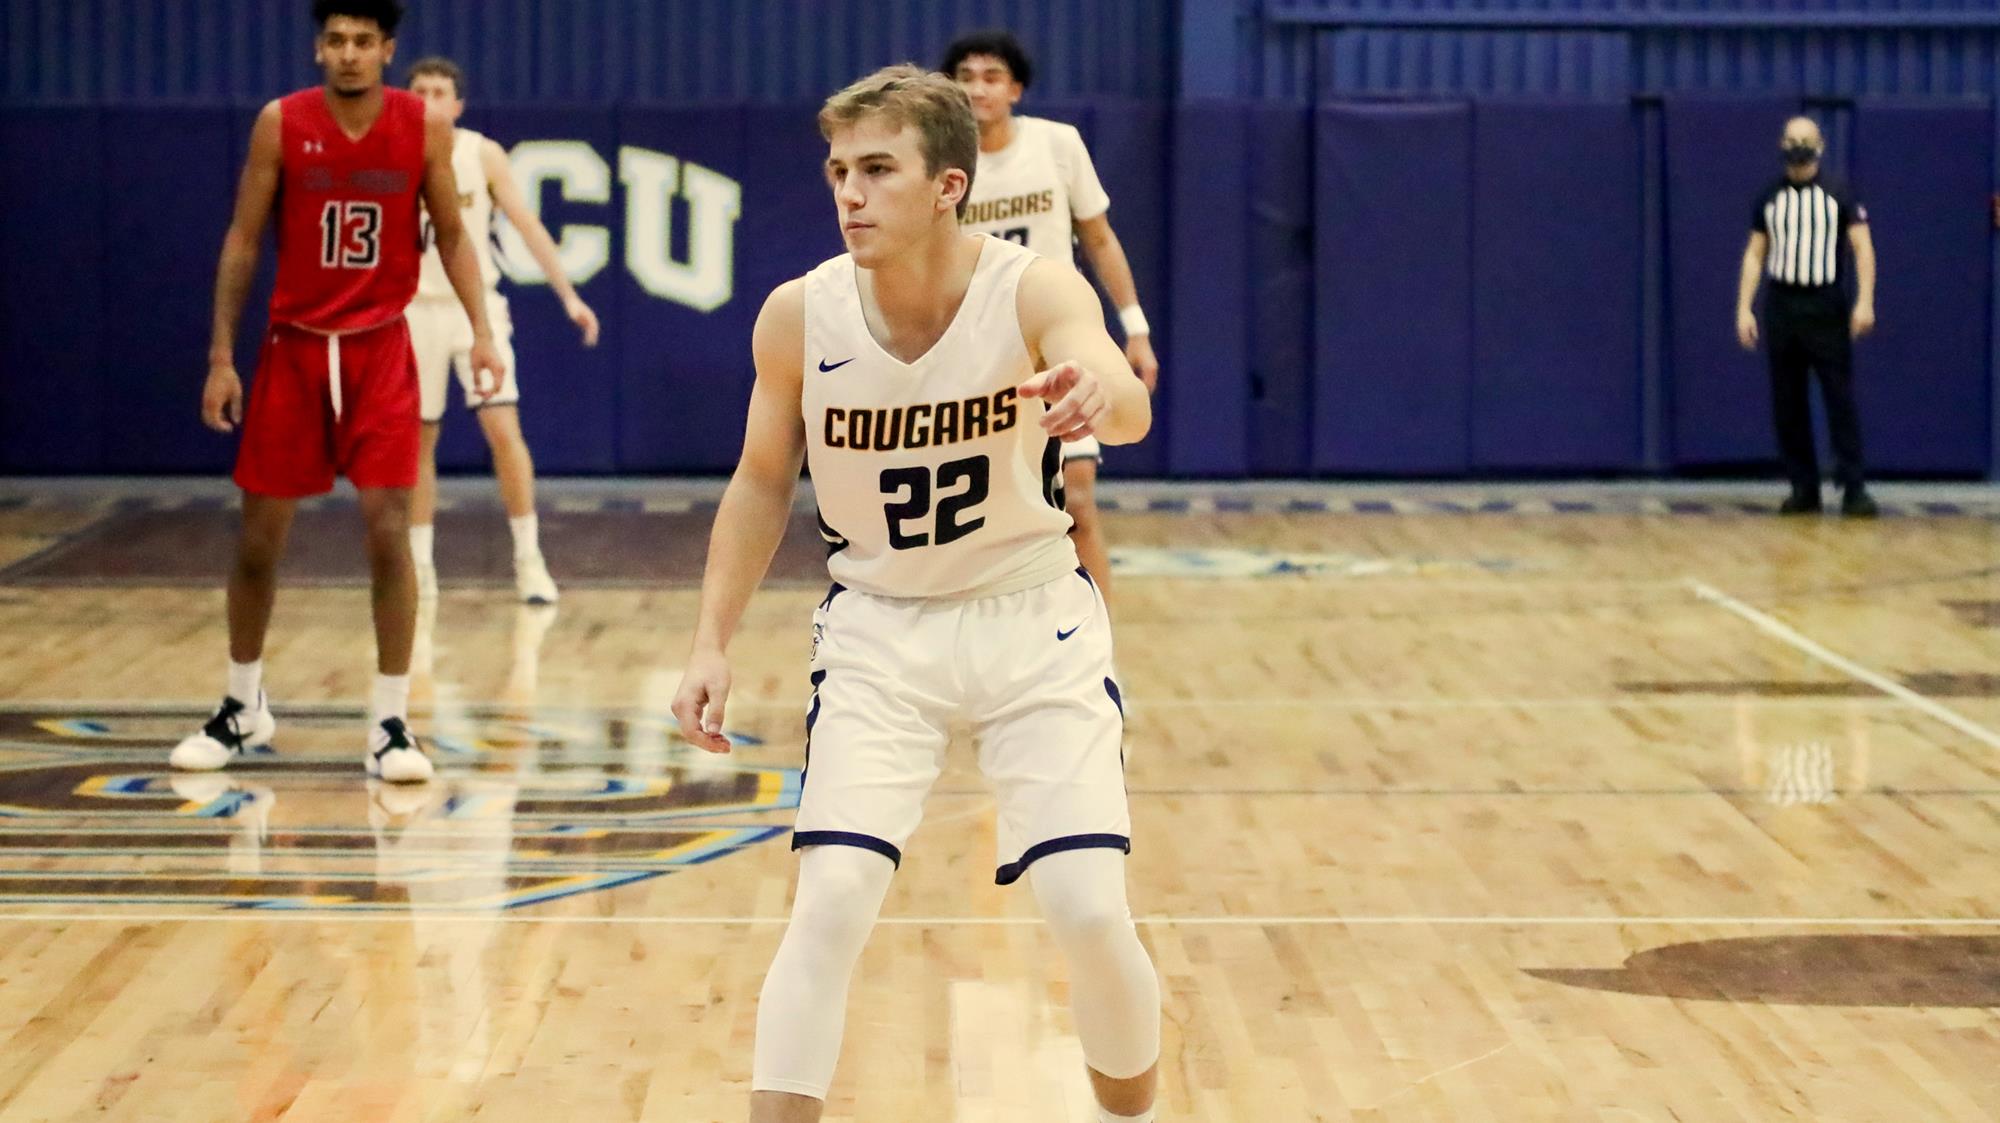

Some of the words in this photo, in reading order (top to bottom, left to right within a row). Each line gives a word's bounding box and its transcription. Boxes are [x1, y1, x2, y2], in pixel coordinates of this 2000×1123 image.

[320, 200, 382, 268] 13
[959, 189, 1053, 225] OUGARS
[824, 386, 1017, 451] COUGARS
[879, 454, 990, 551] 22
